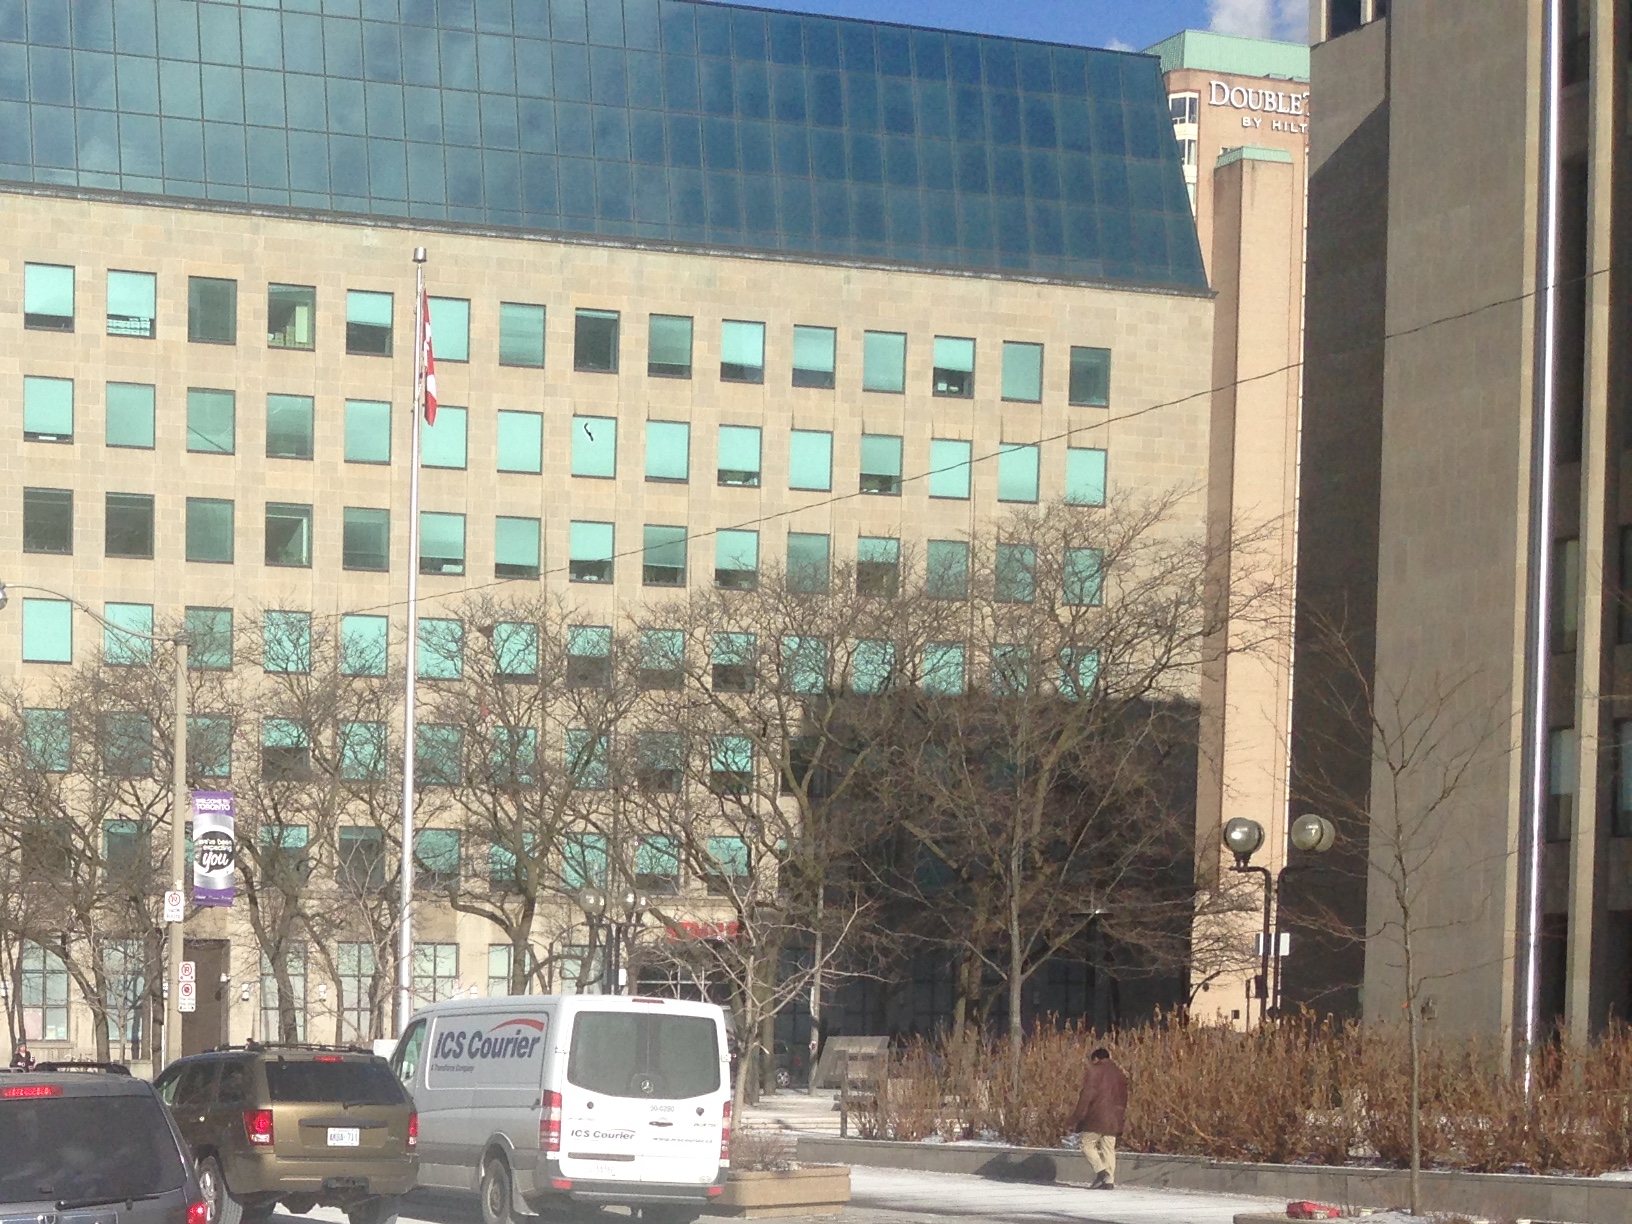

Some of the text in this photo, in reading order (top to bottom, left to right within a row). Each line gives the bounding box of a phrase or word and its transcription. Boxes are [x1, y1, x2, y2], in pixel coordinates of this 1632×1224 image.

[1242, 116, 1262, 129] BY
[196, 803, 230, 811] TORONTO
[202, 850, 229, 871] you
[434, 1029, 541, 1059] ICS Courier
[571, 1129, 635, 1140] ICS Courier
